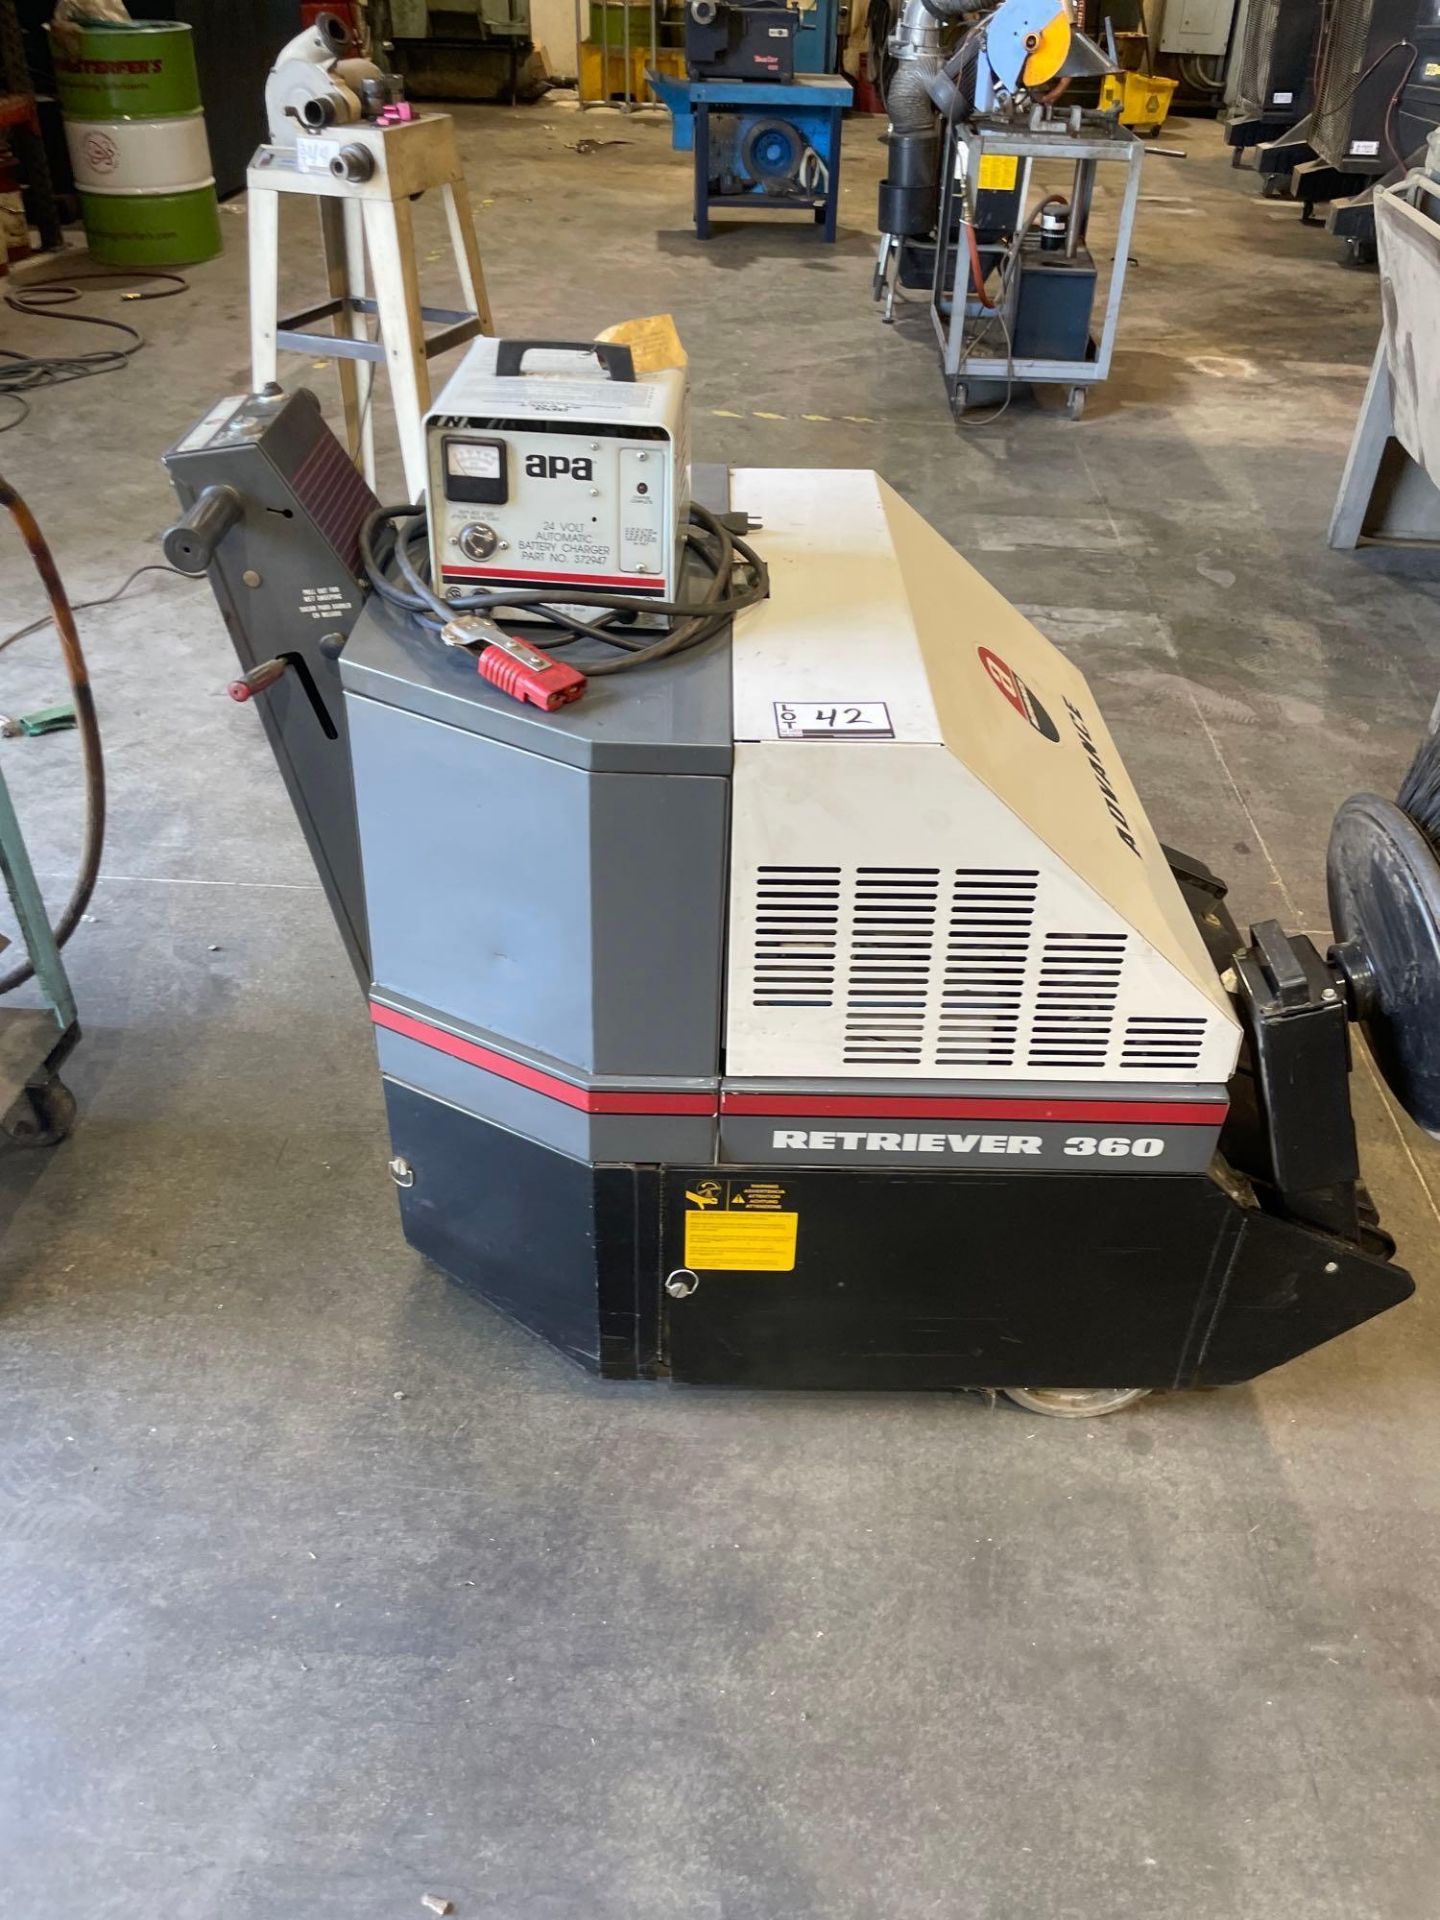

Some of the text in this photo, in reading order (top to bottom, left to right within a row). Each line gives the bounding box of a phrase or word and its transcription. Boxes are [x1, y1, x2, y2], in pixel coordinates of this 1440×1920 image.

[525, 454, 593, 481] apa
[543, 521, 585, 532] 24 VOLT
[536, 532, 593, 544] AUTOMATIC
[518, 541, 610, 555] BATTERY CHARGER
[521, 551, 545, 561] PART
[781, 704, 797, 729] LOT
[816, 708, 873, 727] 42
[1061, 695, 1143, 859] ADVANCE
[772, 1130, 1165, 1157] RETRIEVER 360
